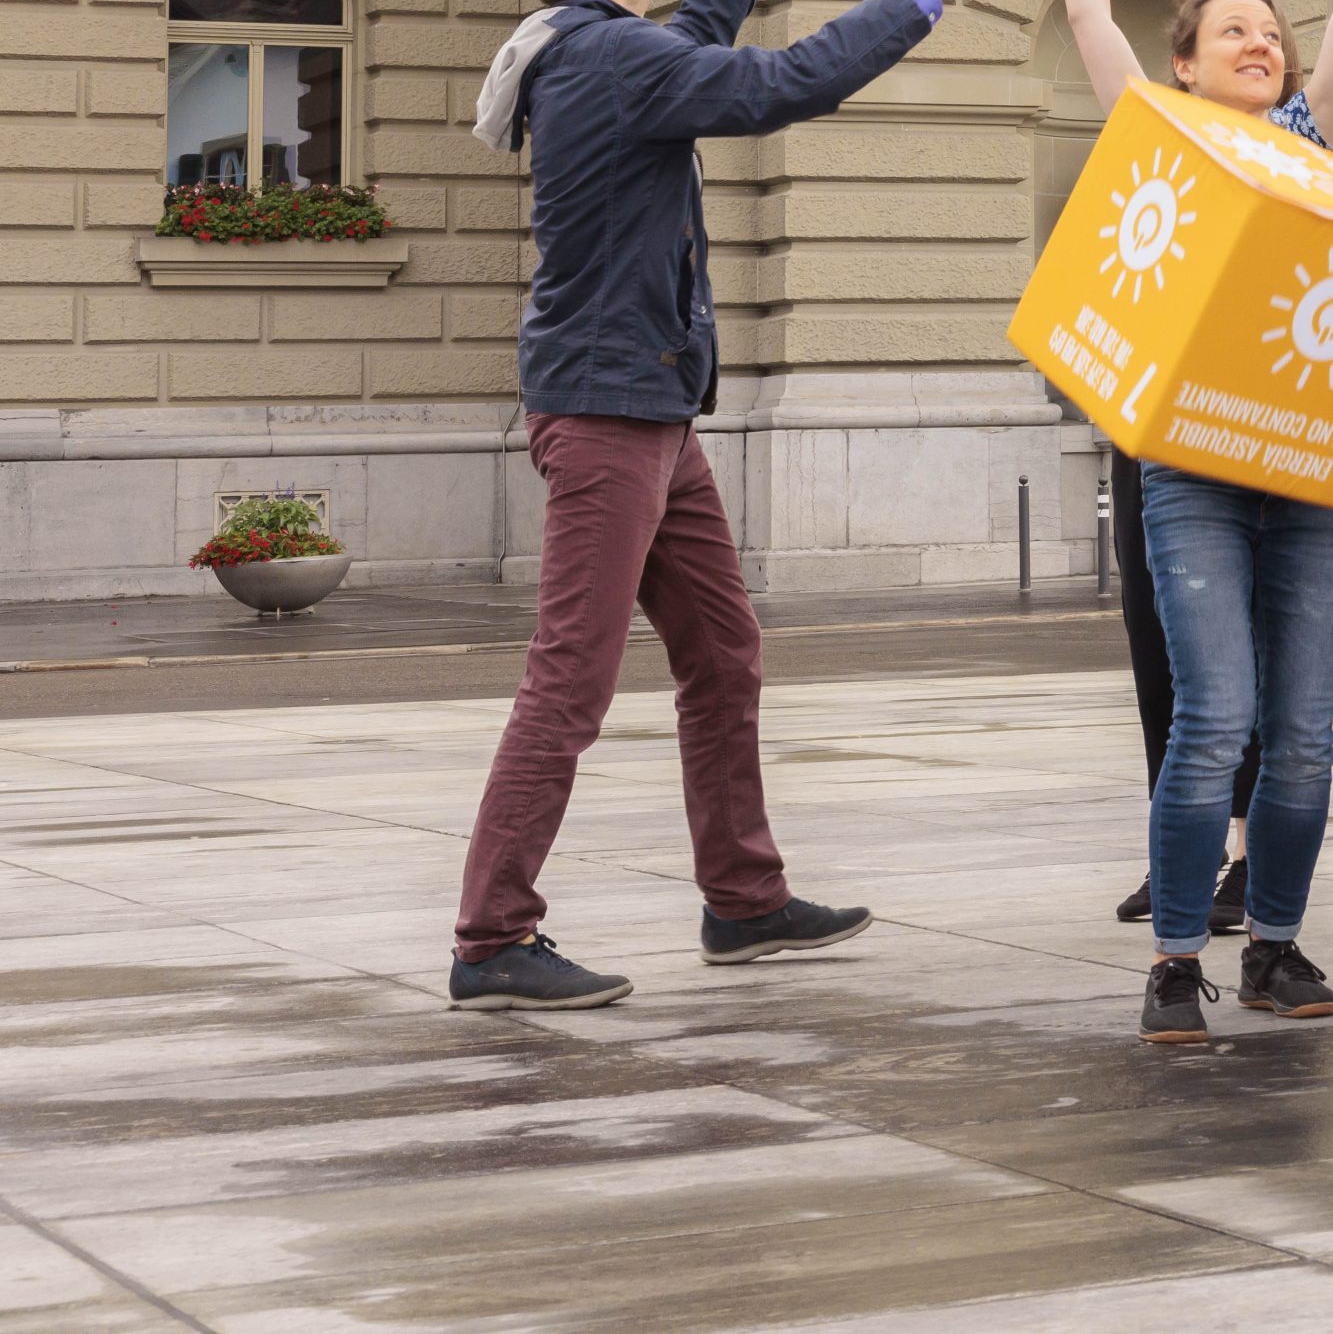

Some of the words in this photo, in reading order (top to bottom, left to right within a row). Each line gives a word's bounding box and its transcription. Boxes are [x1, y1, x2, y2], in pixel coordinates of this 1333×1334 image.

[1121, 362, 1157, 424] 7
[1174, 380, 1308, 439] CONTAMINANTE
[1164, 415, 1263, 463] ASEQUIBLE
